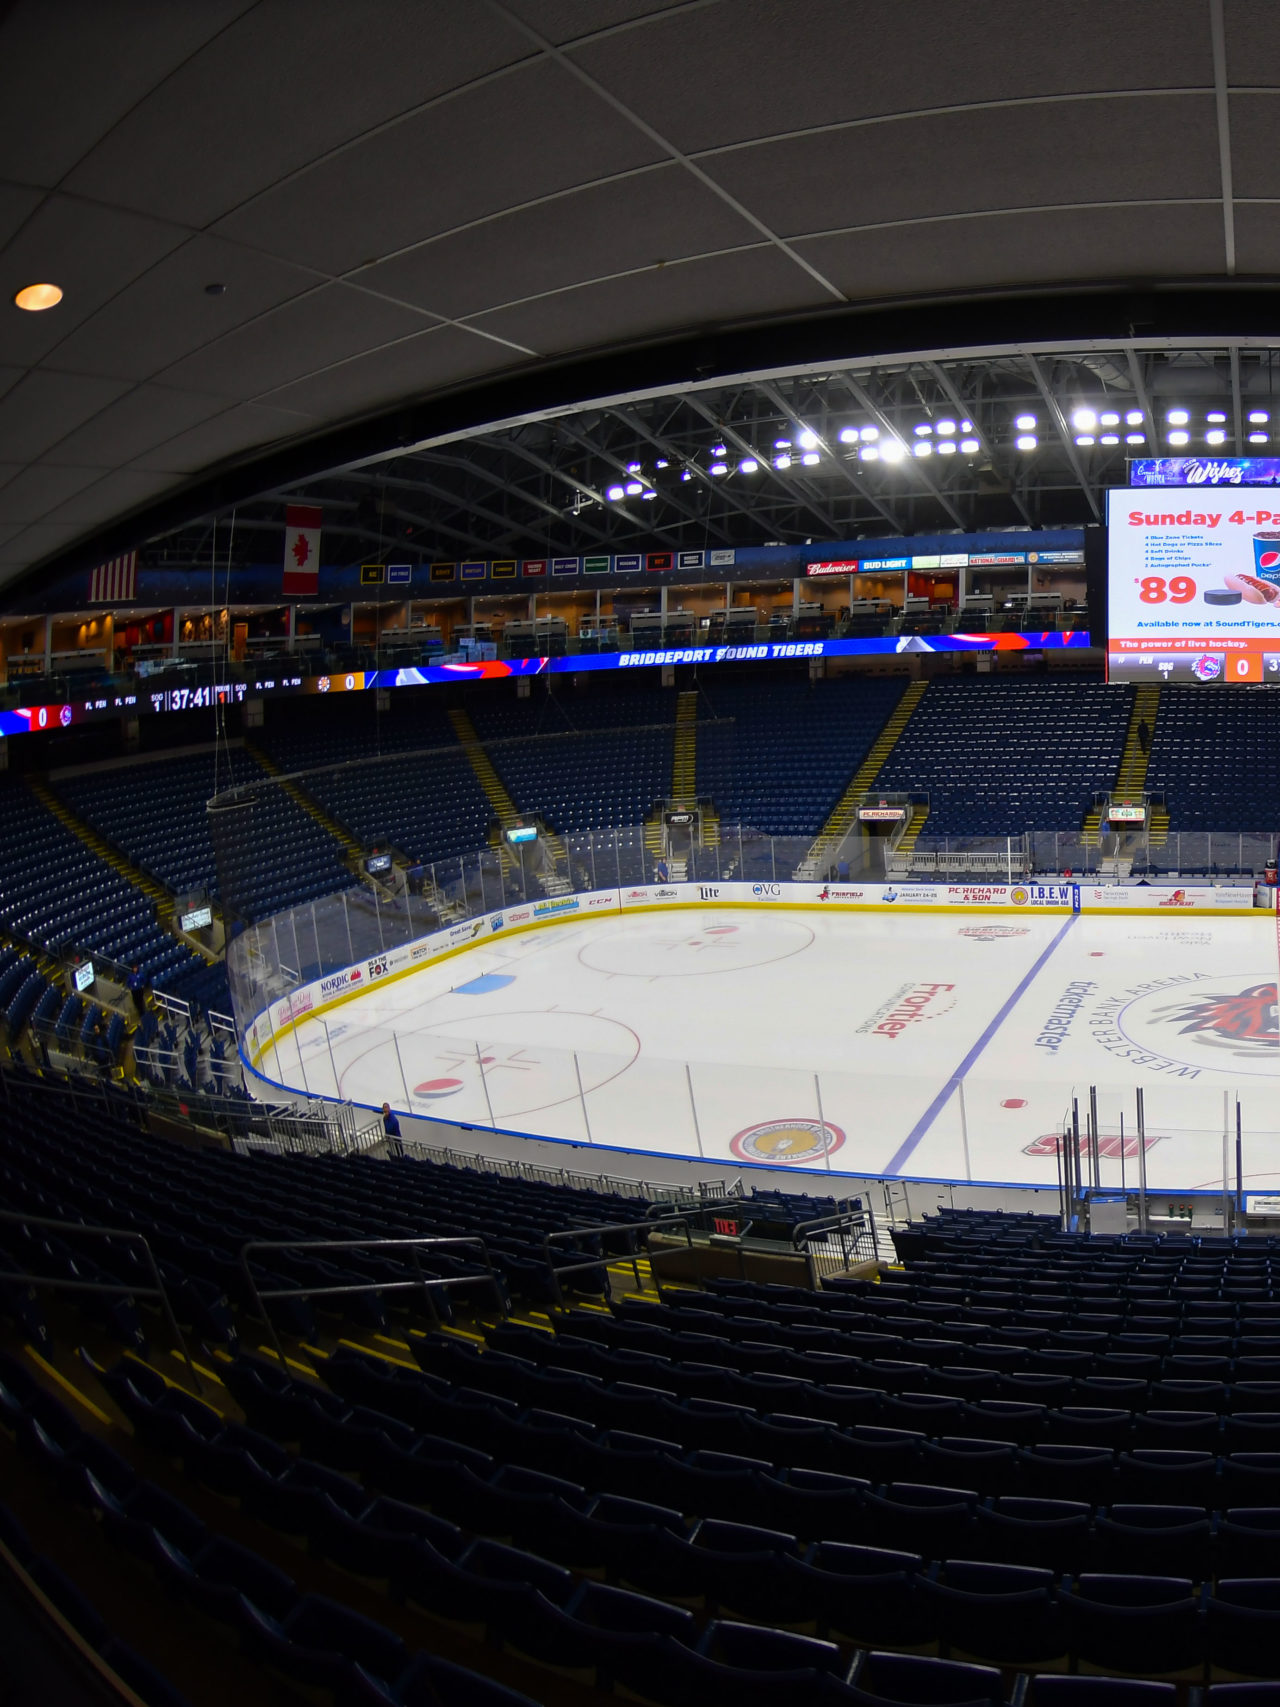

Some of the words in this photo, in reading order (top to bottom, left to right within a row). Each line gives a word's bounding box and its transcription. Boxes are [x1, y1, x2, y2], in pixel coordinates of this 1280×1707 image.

[1128, 510, 1222, 528] Sunday
[807, 564, 856, 575] Budweiser
[864, 561, 881, 570] BUD
[882, 559, 907, 568] LIGHT
[1137, 620, 1180, 628] Available
[619, 649, 713, 666] BRIDGEPORT
[716, 646, 768, 662] SOUND
[772, 643, 824, 657] TIGERS
[1163, 671, 1169, 679] 1
[1237, 659, 1249, 676] 0
[346, 676, 354, 690] 0
[172, 686, 210, 710] 37:41
[219, 692, 225, 704] 1
[237, 691, 243, 701] 1
[154, 702, 160, 712] 1
[39, 708, 47, 727] 0
[700, 886, 720, 900] Lite
[752, 883, 781, 895] OVG
[1031, 886, 1069, 899] I.B.E.W
[589, 897, 612, 905] CCM
[369, 962, 389, 978] FOX
[321, 973, 349, 993] NORDIC
[1125, 972, 1212, 996] ARENA
[872, 983, 956, 1039] Frontier
[1034, 980, 1100, 1052] ticketmaster
[1089, 996, 1131, 1025] BANK
[1092, 1028, 1202, 1080] WEBSTER
